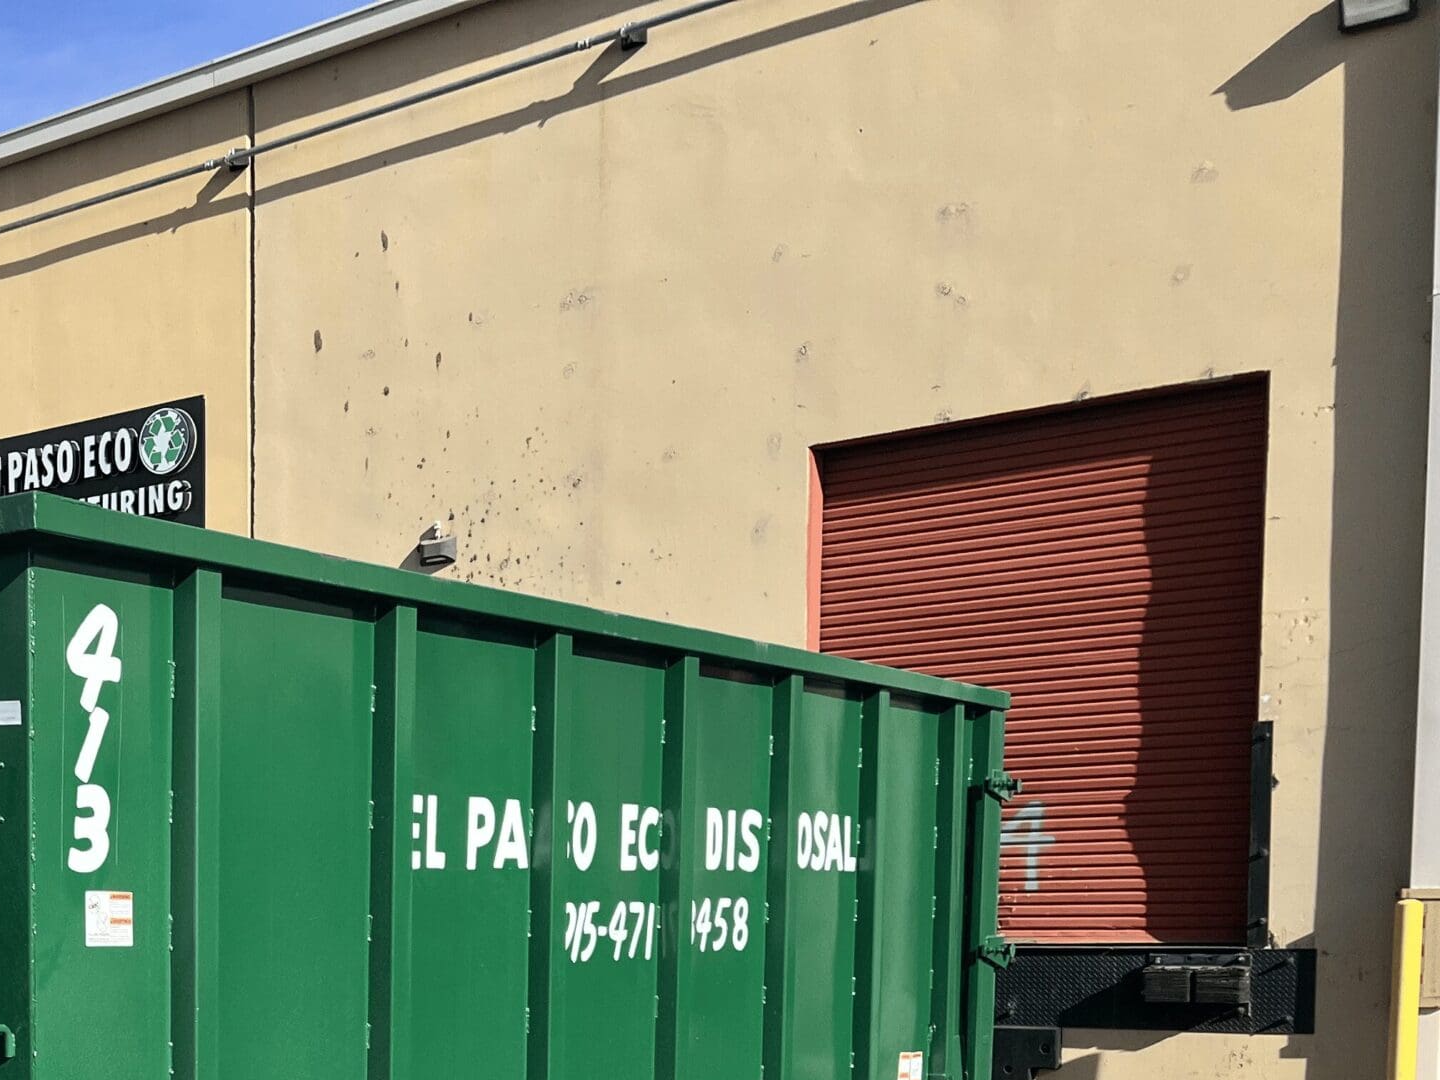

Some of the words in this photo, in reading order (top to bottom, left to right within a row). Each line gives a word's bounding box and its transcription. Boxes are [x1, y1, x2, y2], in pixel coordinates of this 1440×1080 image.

[8, 440, 73, 493] PASO
[83, 428, 131, 479] ECO
[466, 796, 597, 872] PAO
[620, 803, 660, 871] EC
[705, 807, 857, 873] DISOSAL
